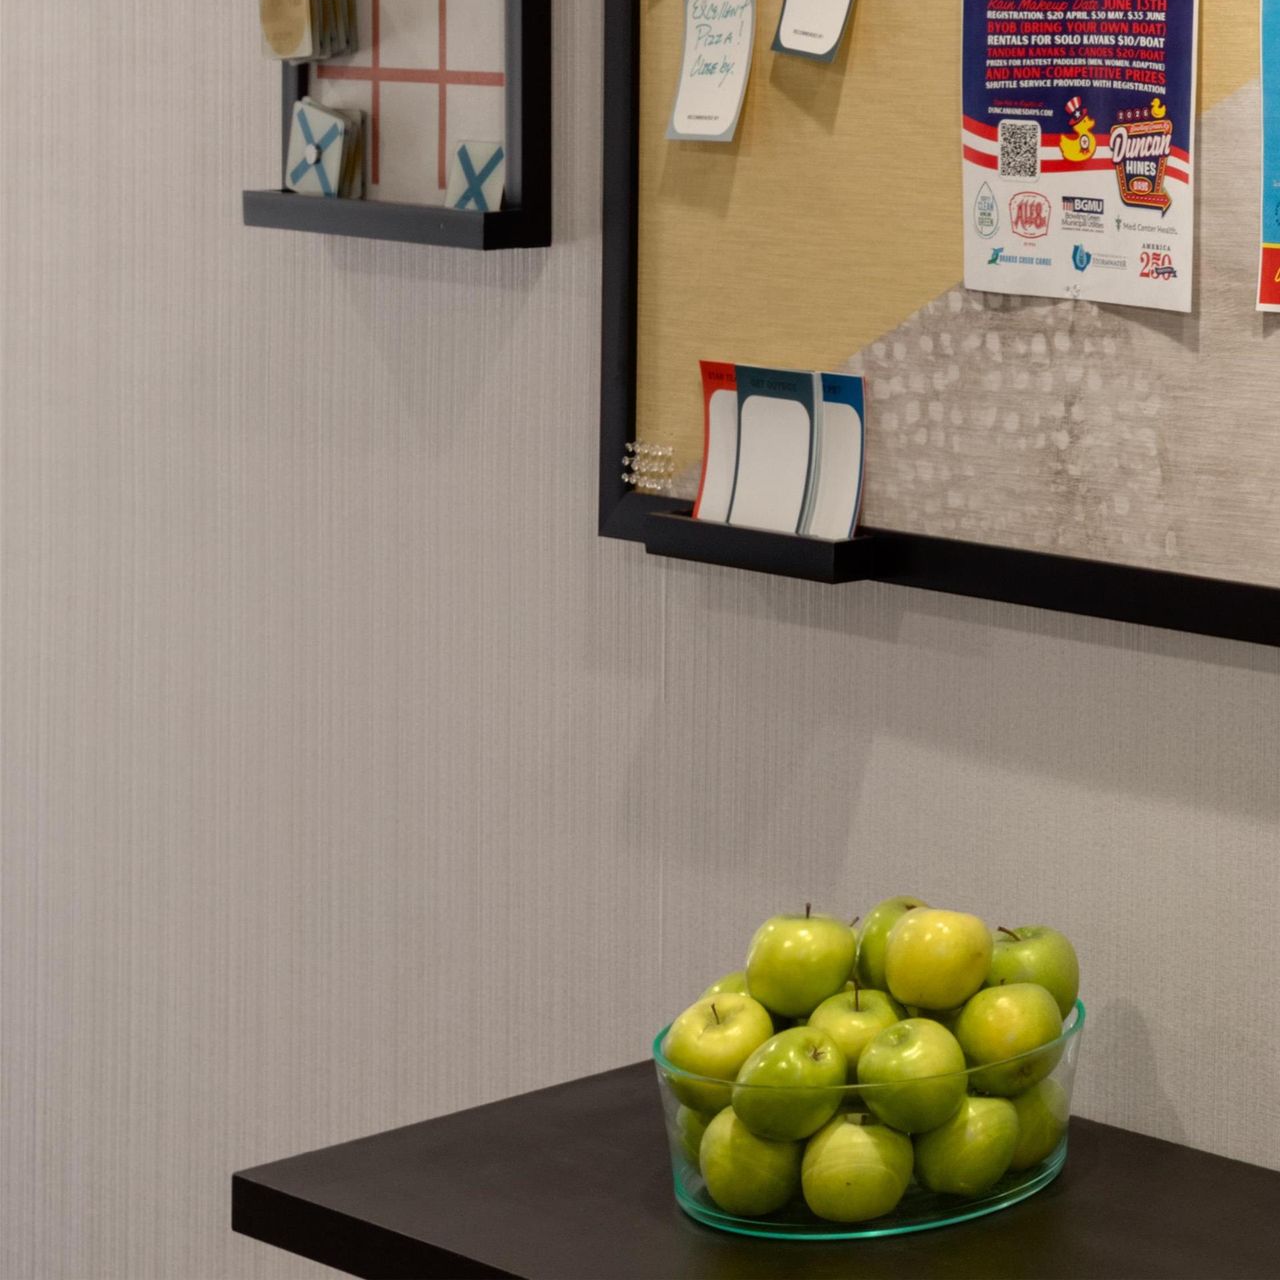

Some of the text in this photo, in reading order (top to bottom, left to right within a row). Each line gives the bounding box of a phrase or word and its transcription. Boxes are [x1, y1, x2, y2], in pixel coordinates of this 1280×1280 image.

[1111, 127, 1171, 164] Duncan
[1126, 161, 1157, 176] HINES
[1074, 198, 1103, 212] BGMU
